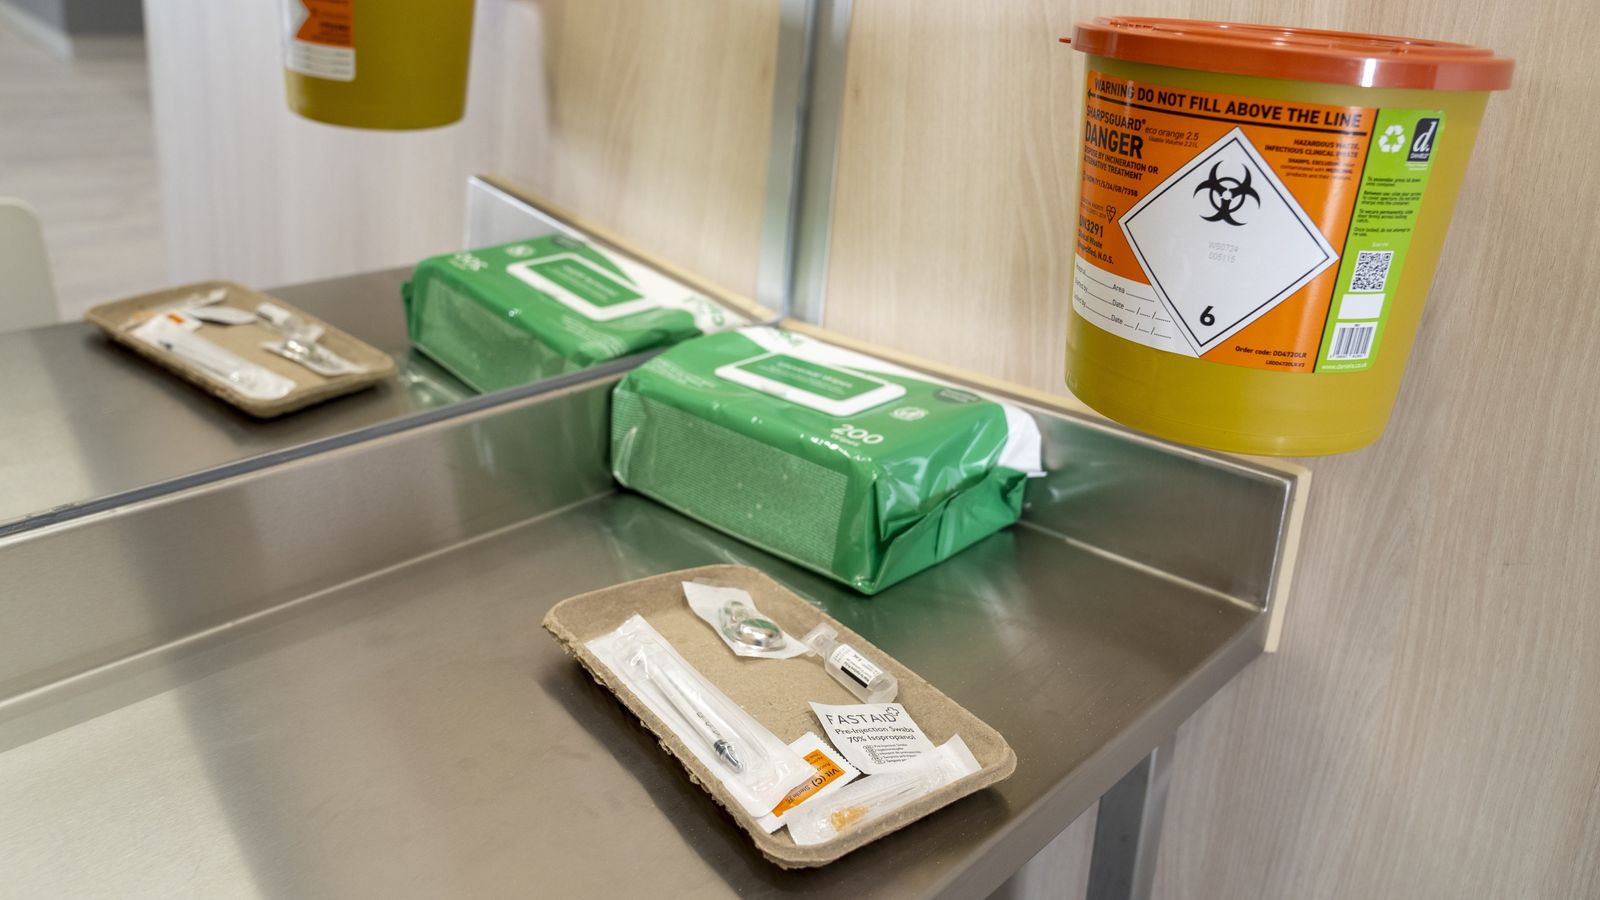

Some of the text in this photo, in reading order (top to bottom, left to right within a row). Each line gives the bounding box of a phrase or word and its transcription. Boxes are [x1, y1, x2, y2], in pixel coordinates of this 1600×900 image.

[1095, 79, 1362, 128] WARNING DO NOT FILL ABOVE THE LINE
[1145, 126, 1199, 141] eco orange 2.5
[1085, 120, 1143, 160] DANGER
[1294, 139, 1334, 148] HAZARDOUS
[1264, 144, 1304, 154] INFECTIOUS
[1305, 148, 1334, 156] CLINICAL
[1098, 152, 1104, 160] BY
[1105, 154, 1146, 172] INCINERATION
[1148, 166, 1158, 175] OR
[1108, 164, 1143, 181] TREATMENT
[1098, 252, 1114, 264] N.O.S.
[1112, 284, 1125, 294] Area
[1112, 300, 1124, 310] Date
[1112, 314, 1123, 325] Date
[1200, 306, 1215, 326] 6
[1235, 346, 1253, 354] Order
[1255, 348, 1272, 356] code:
[830, 424, 884, 444] 200
[826, 713, 896, 725] FAST AID
[835, 725, 915, 735] Pre-Injection Swabs
[846, 734, 916, 744] 70% Isopropanol
[825, 768, 839, 778] Vit
[812, 776, 826, 787] (C)
